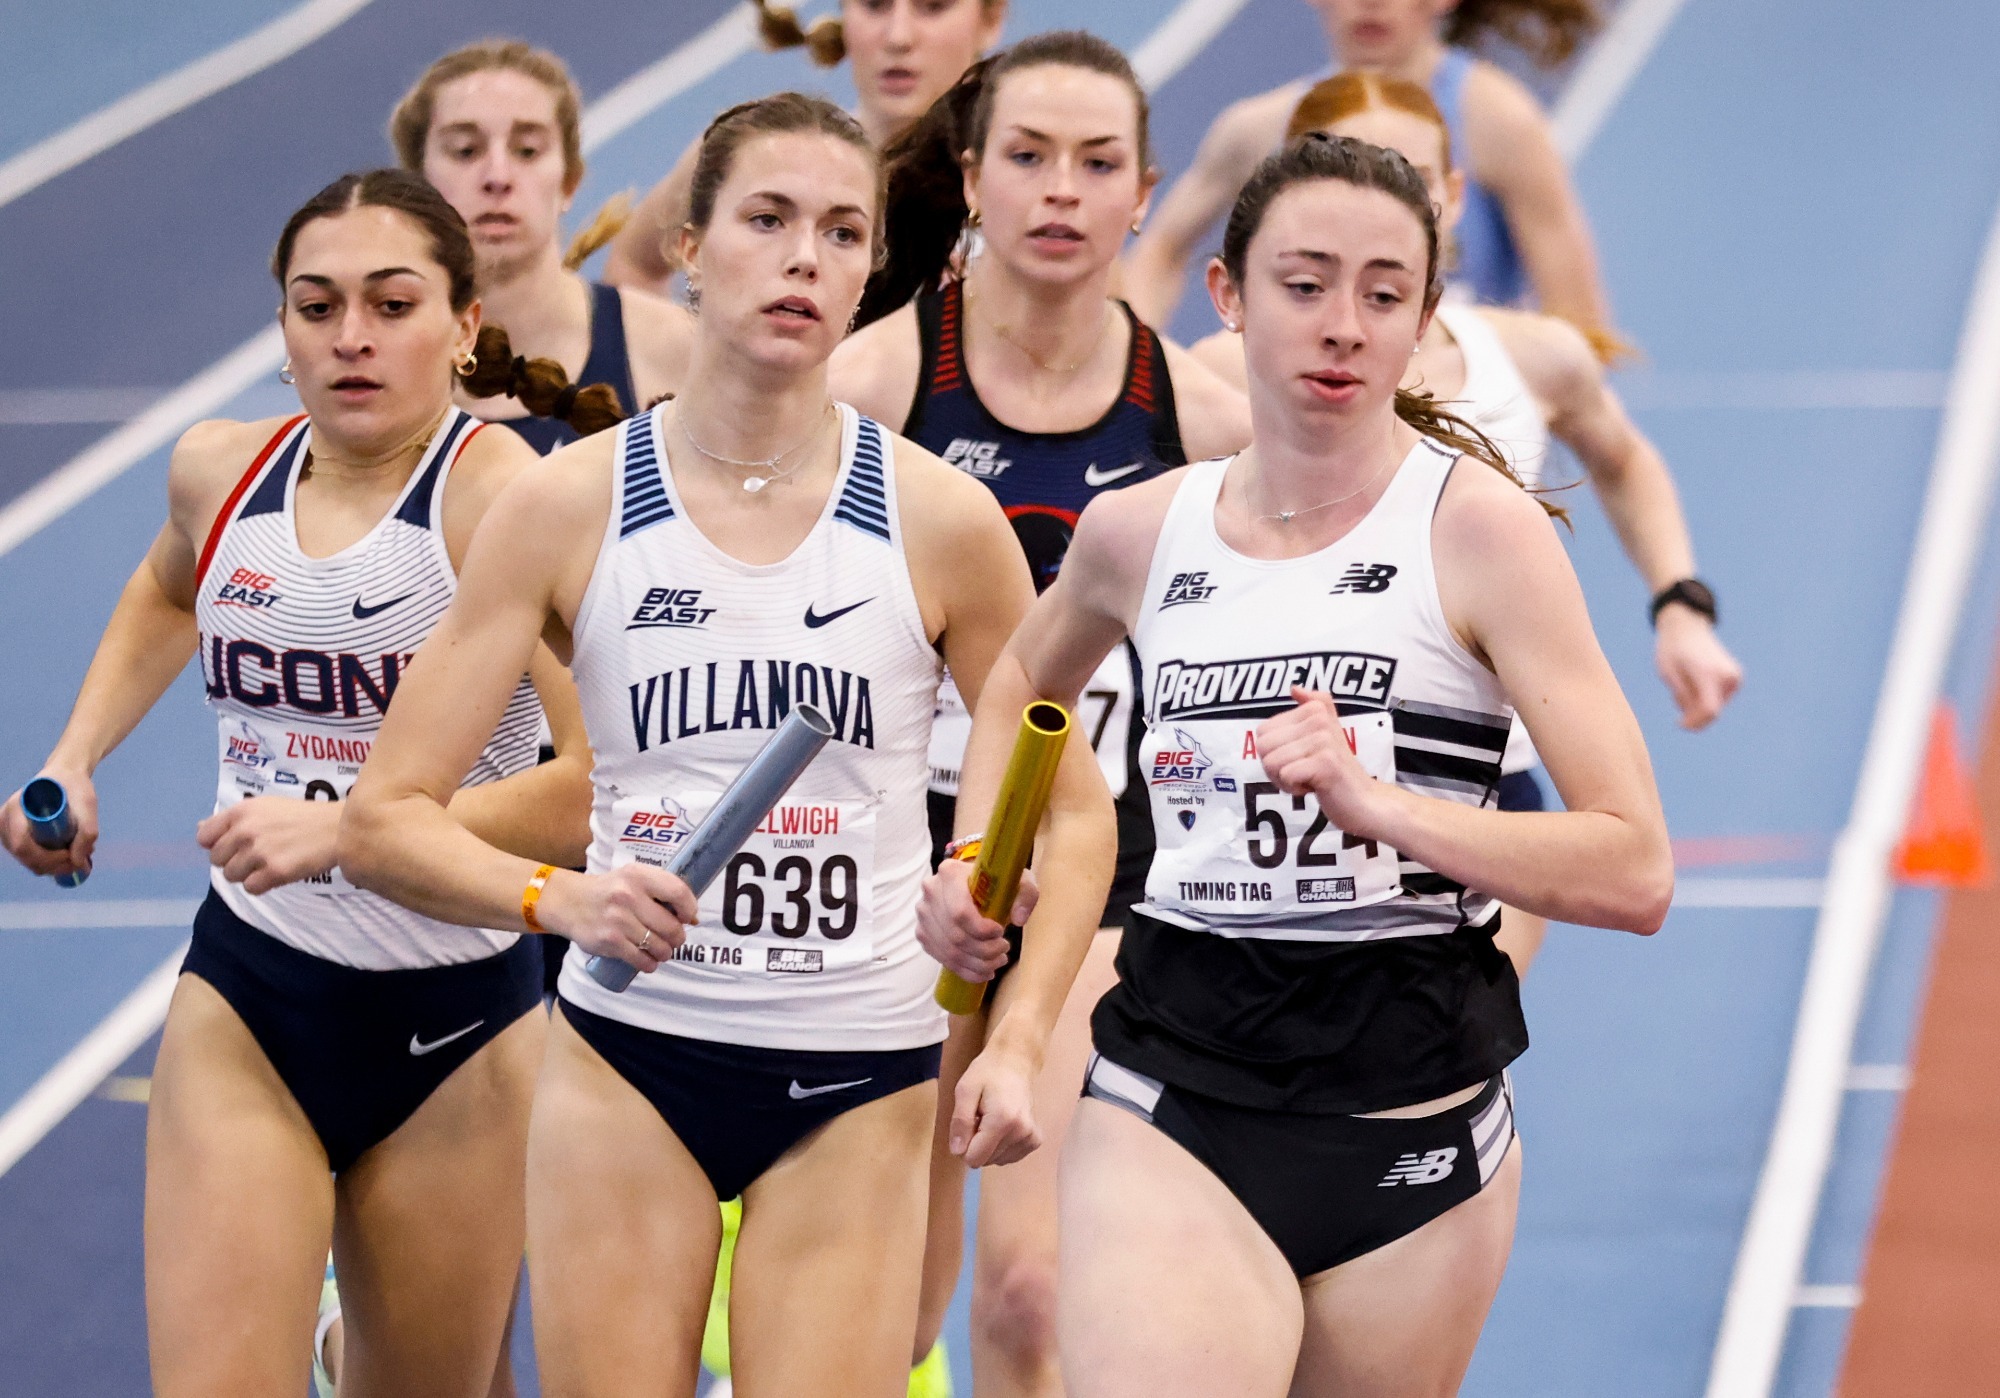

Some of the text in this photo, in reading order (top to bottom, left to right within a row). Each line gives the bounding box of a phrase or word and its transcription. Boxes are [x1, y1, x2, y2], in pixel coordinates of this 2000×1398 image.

[942, 438, 1000, 460] BIG
[230, 568, 277, 590] BIG
[1169, 571, 1209, 588] BIG
[219, 583, 283, 608] EAST
[641, 588, 703, 606] BIG
[1162, 586, 1219, 604] EAST
[632, 606, 718, 624] EAST
[200, 632, 415, 718] UCON
[1153, 654, 1395, 721] PROVIDENCE
[629, 660, 875, 753] VILLANOVA
[229, 736, 259, 754] BIG
[285, 732, 371, 765] ZYDANO
[226, 747, 271, 769] EAST
[1154, 751, 1194, 766] BIG
[1152, 766, 1207, 780] EAST
[1167, 796, 1205, 807] Hosted by
[630, 812, 677, 829] BIG
[623, 825, 689, 844] EAST
[773, 838, 815, 849] VILLANOVA
[721, 852, 859, 940] 639
[1178, 882, 1272, 902] TIMING TAG
[1300, 890, 1354, 901] CHANGE
[711, 946, 742, 965] TAG
[768, 961, 822, 972] CHANGE
